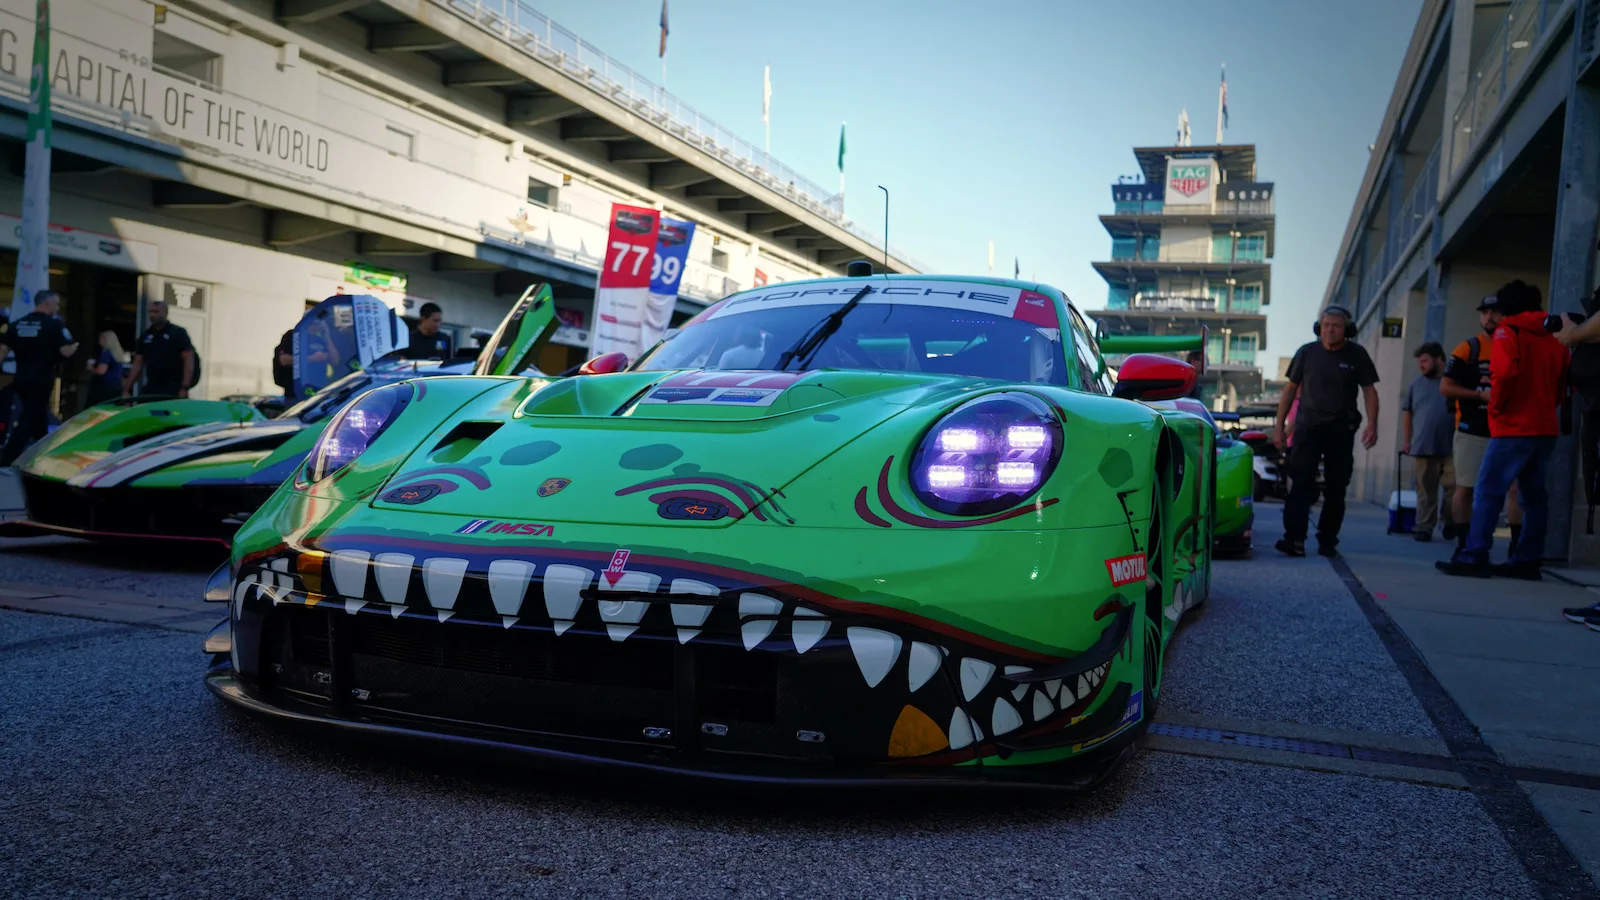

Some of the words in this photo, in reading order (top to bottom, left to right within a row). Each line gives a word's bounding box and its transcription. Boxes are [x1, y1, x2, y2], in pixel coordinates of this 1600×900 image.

[52, 48, 153, 120] APITAL
[164, 86, 195, 130] OF
[203, 98, 246, 147] THE
[254, 115, 329, 173] WORLD
[1174, 166, 1207, 178] TAG
[1171, 178, 1209, 196] HEUER
[611, 241, 650, 277] 77
[726, 286, 1010, 309] PORSCHE
[485, 522, 555, 537] IMSA
[610, 551, 626, 573] TOW
[1110, 557, 1146, 583] MOTUL
